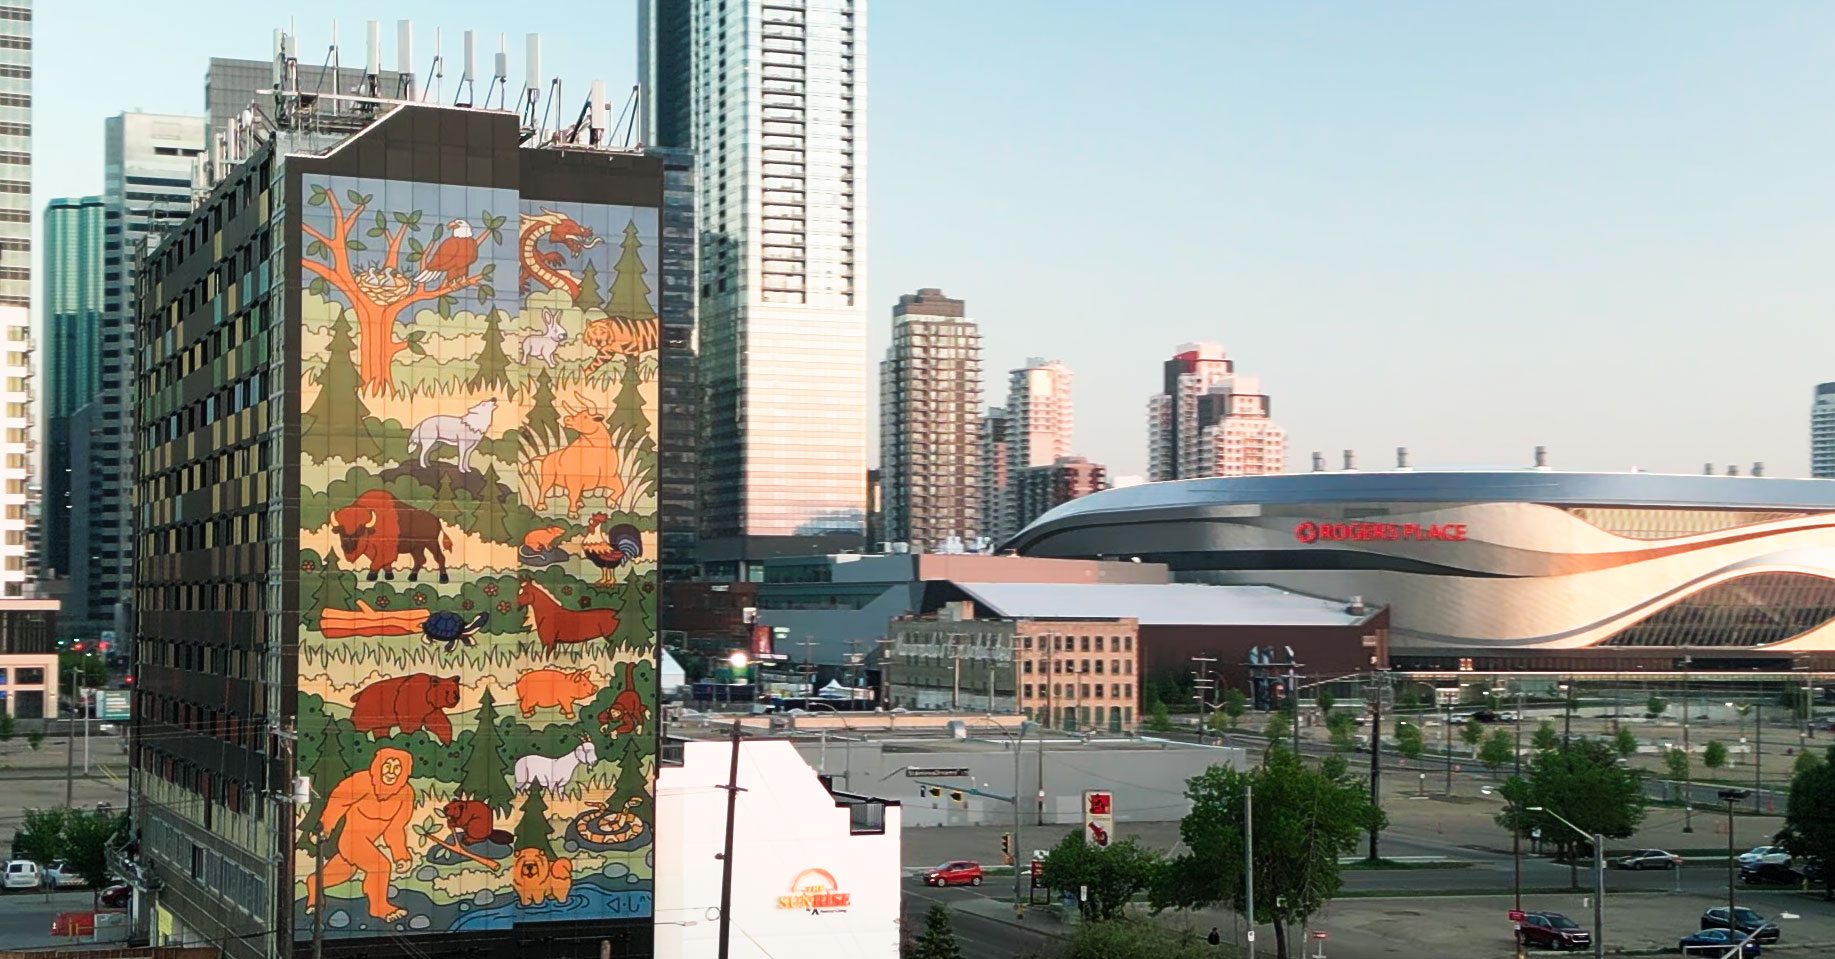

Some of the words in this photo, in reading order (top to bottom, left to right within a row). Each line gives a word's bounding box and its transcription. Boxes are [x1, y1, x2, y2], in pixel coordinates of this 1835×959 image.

[1320, 523, 1399, 541] ROGERS
[1403, 523, 1467, 541] PLACE
[777, 893, 851, 909] SUNRISE
